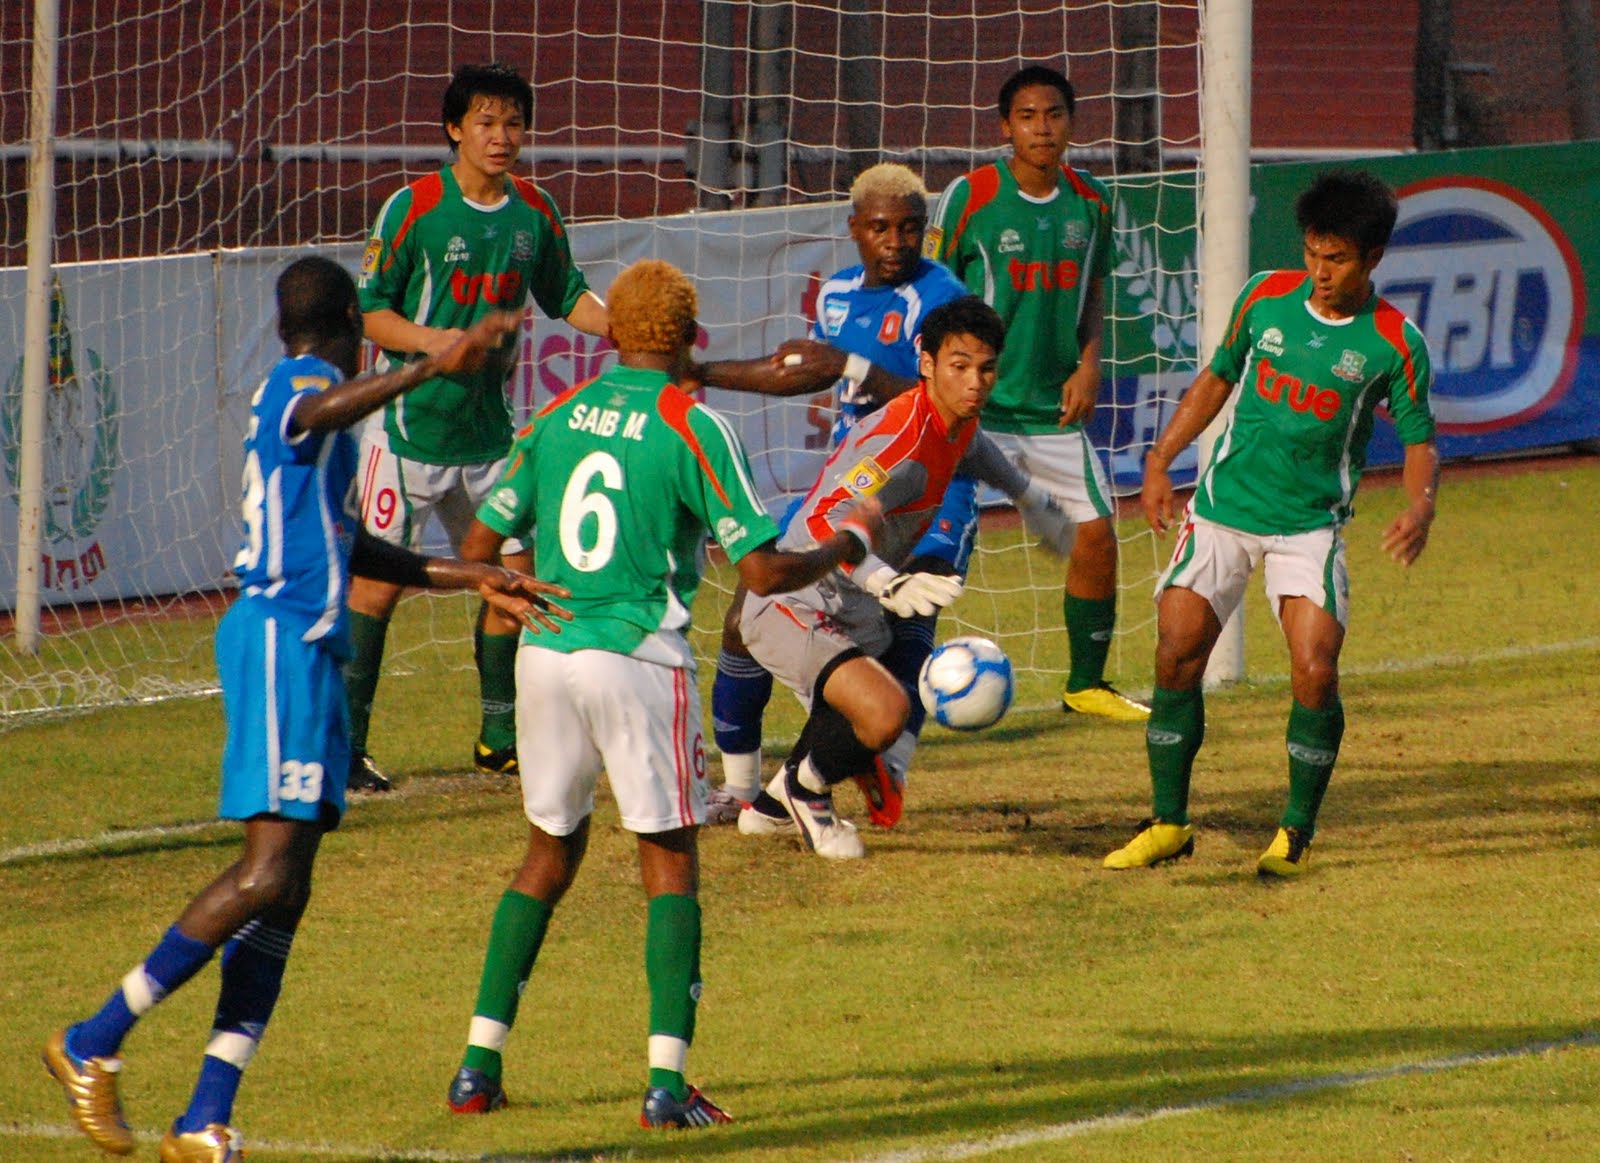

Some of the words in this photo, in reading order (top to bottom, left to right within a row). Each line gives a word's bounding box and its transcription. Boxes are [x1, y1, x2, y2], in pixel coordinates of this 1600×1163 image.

[450, 267, 521, 304] true
[1007, 256, 1080, 291] true
[1256, 338, 1285, 357] Chang
[1255, 356, 1342, 421] true
[567, 402, 621, 438] SAIB
[622, 411, 650, 442] M.
[374, 487, 397, 530] 9
[559, 451, 623, 572] 6
[692, 732, 705, 780] 6
[279, 760, 324, 803] 33
